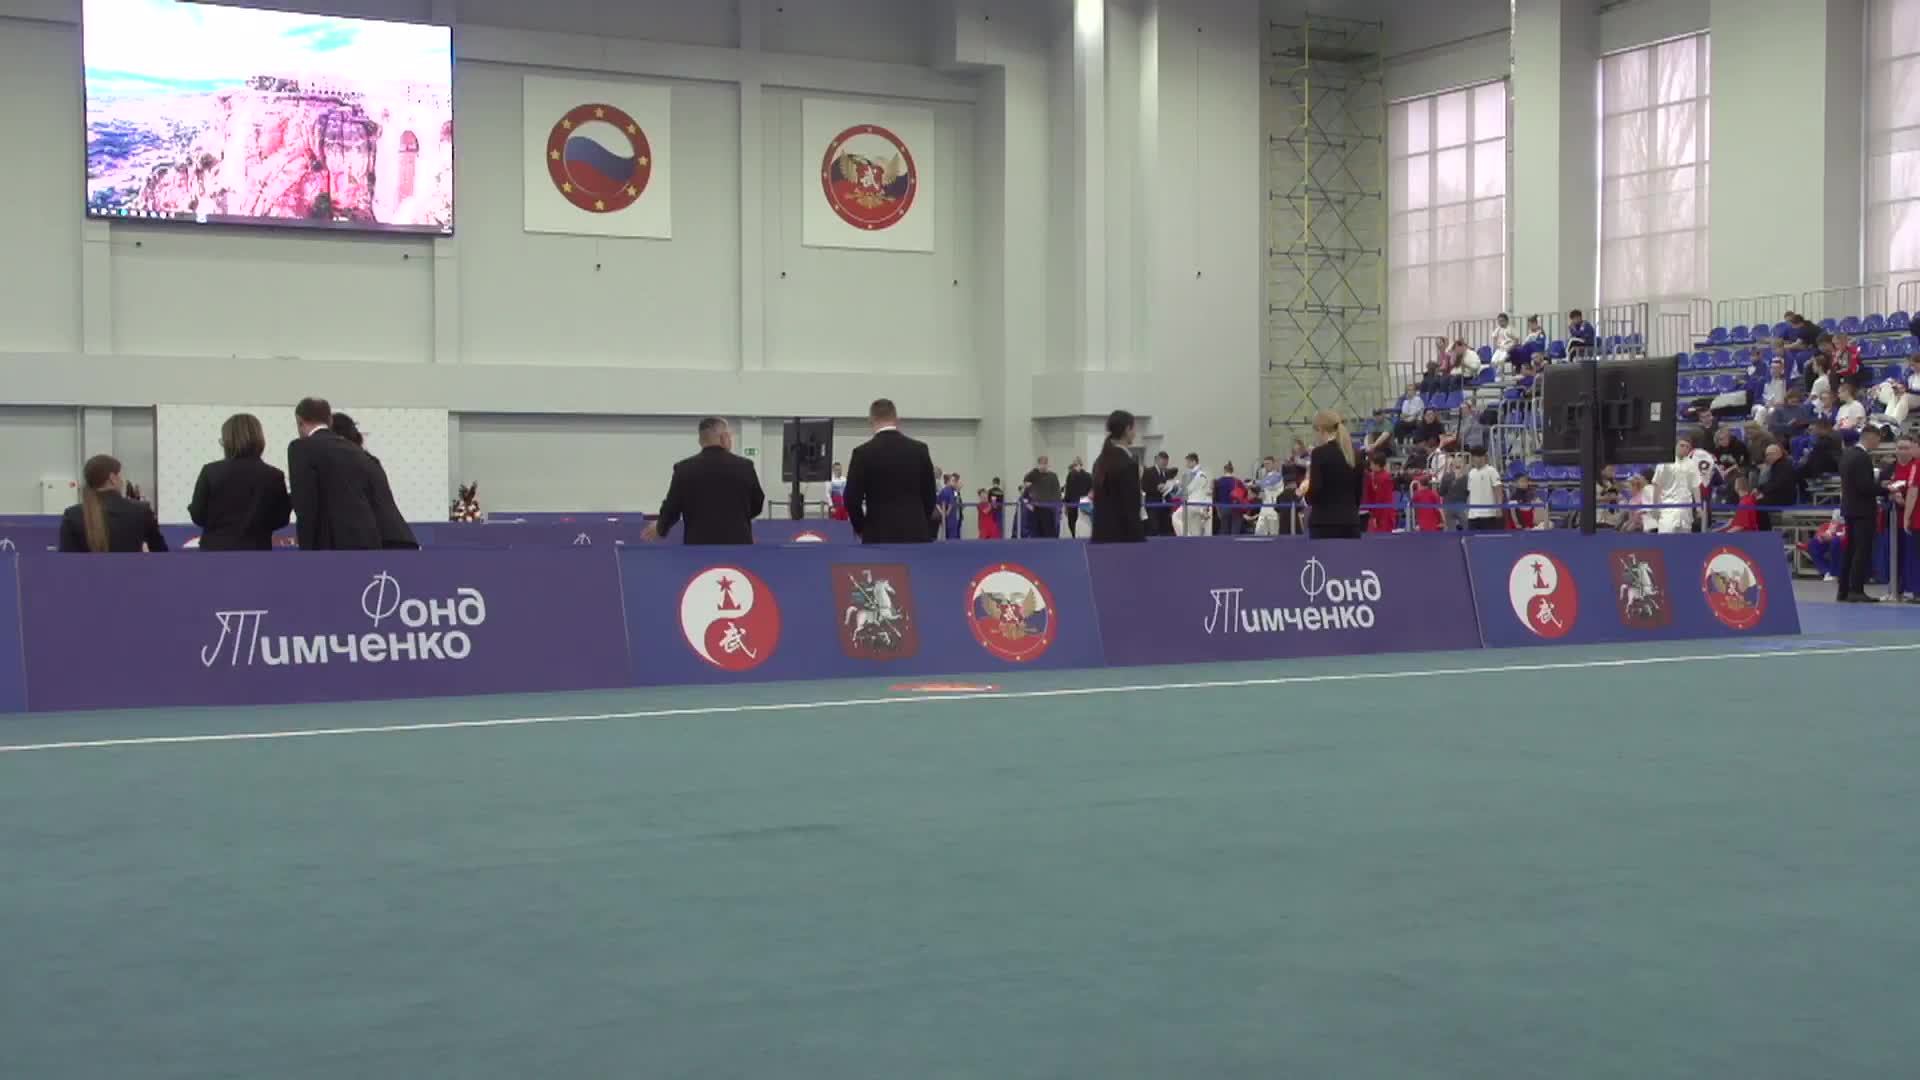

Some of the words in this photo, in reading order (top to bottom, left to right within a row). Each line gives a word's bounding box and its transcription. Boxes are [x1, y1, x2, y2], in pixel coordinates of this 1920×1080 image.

[361, 570, 487, 627] Фонд
[1300, 555, 1382, 603] Фонд
[1204, 587, 1376, 634] Тимченко
[201, 609, 472, 667] Тимченко
